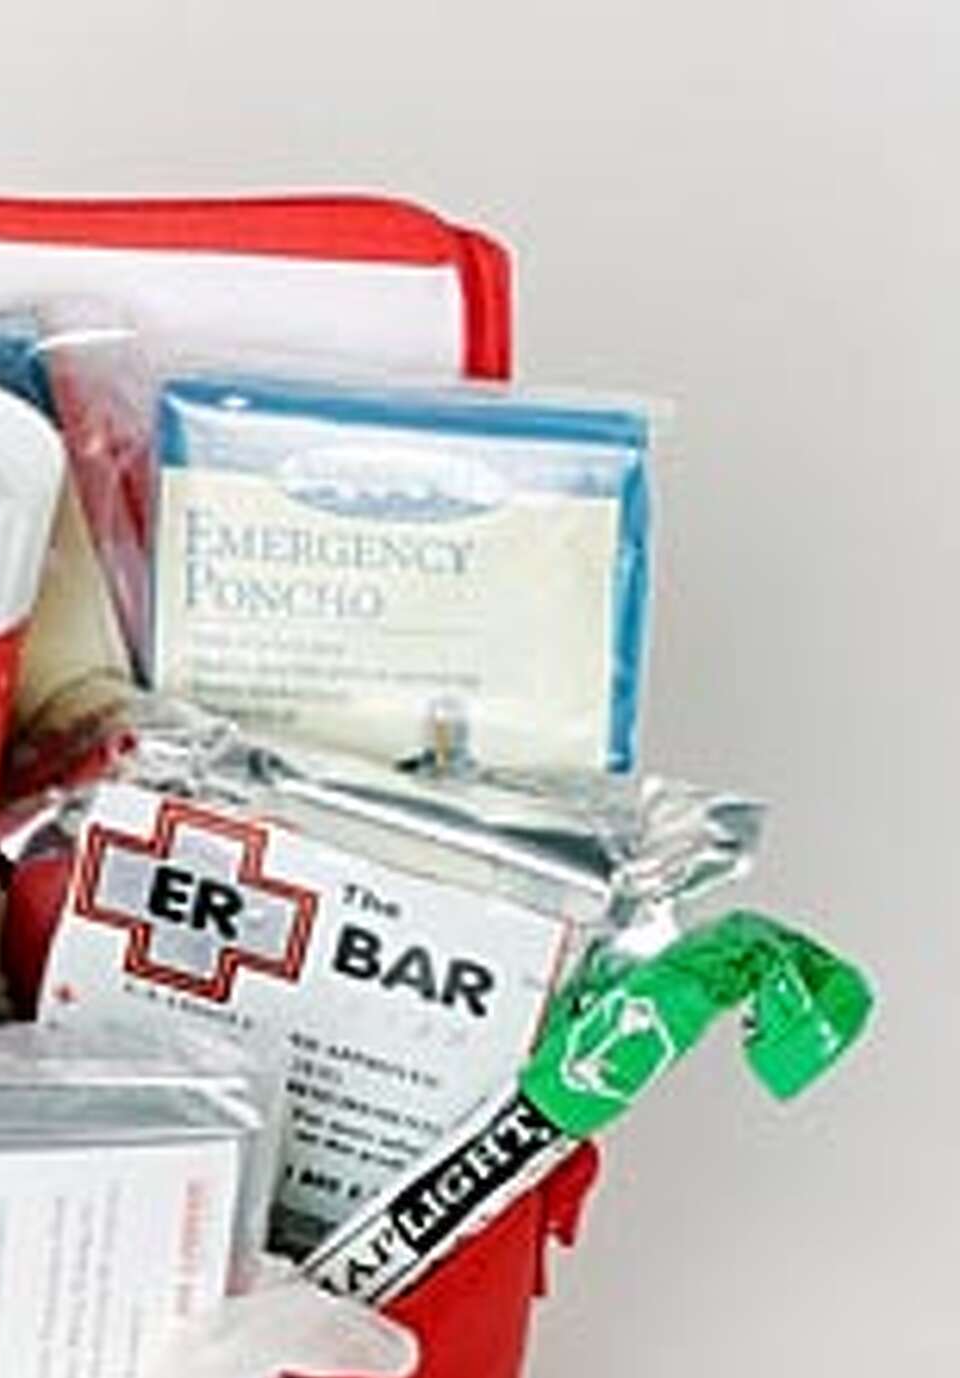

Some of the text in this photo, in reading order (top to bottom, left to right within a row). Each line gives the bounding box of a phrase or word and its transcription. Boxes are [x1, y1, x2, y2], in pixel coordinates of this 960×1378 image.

[185, 507, 474, 575] EMERGENCY
[185, 559, 384, 619] PONCHO
[146, 865, 247, 939] ER
[341, 883, 401, 918] The
[333, 926, 494, 1018] BAR
